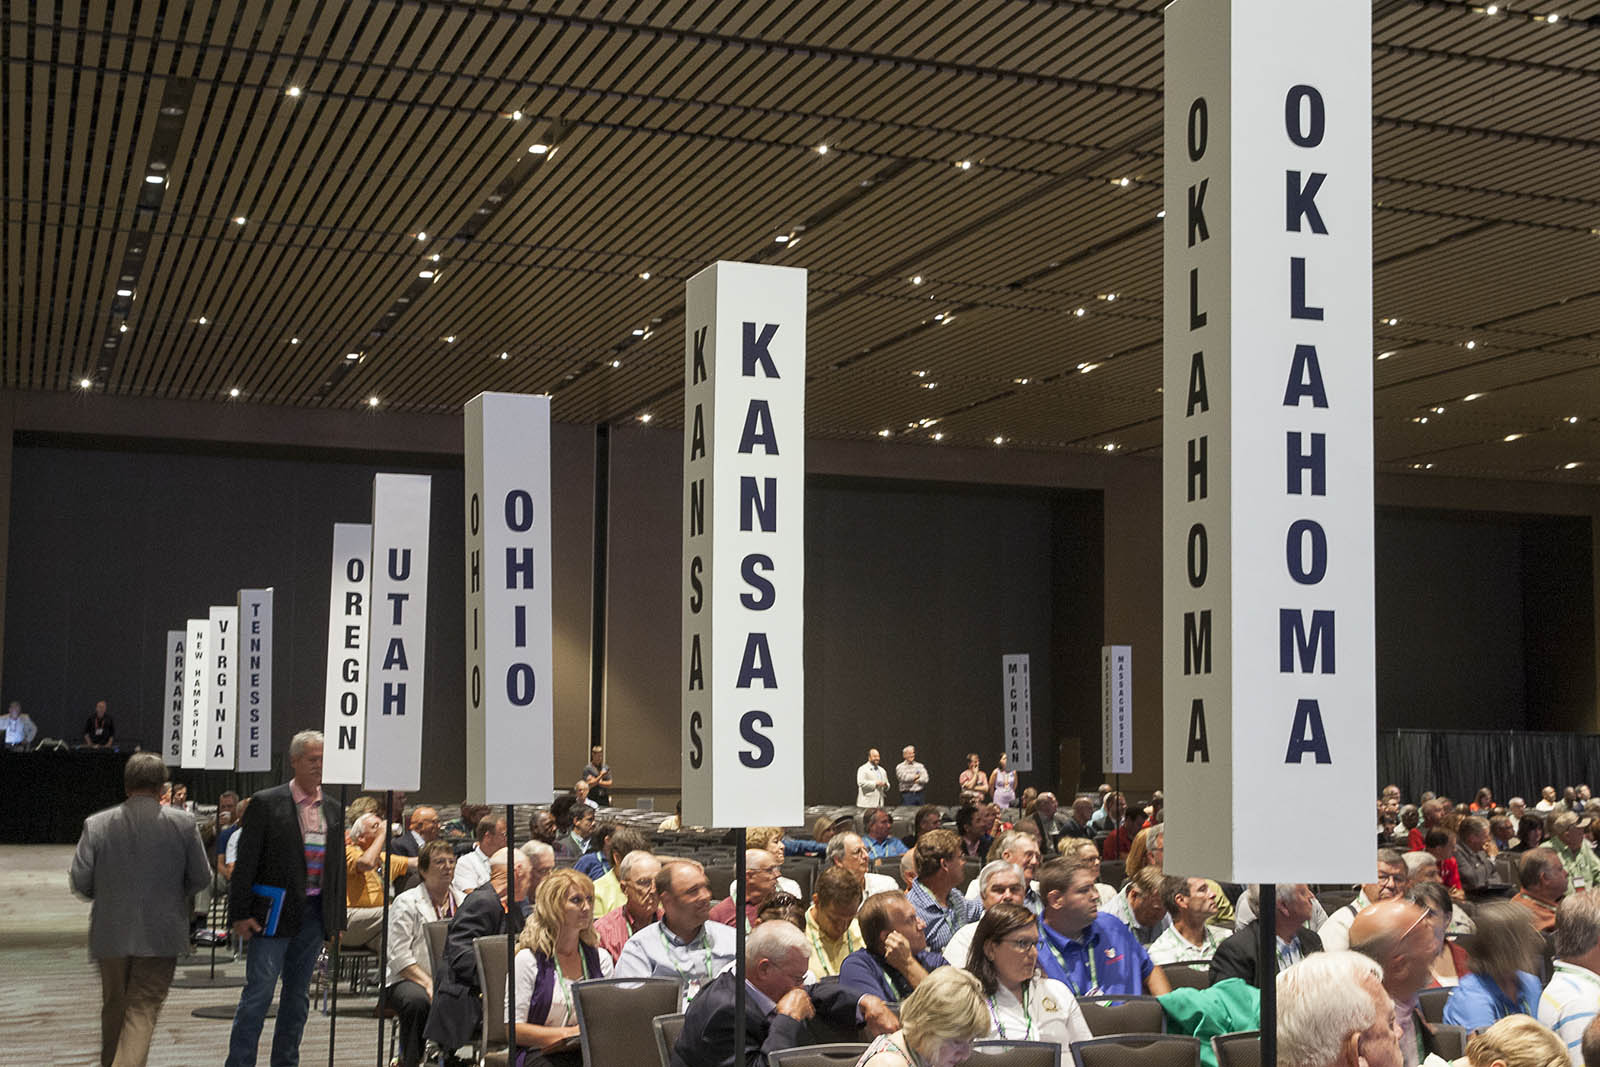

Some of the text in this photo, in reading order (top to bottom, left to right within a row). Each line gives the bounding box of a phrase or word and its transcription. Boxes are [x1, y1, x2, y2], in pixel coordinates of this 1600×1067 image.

[1183, 96, 1213, 764] OKLAHOMA
[1279, 83, 1337, 766] OKLAHOMA
[381, 548, 412, 716] UTAH
[470, 492, 480, 709] OHIO
[504, 489, 536, 707] OHIO
[688, 325, 708, 770] KANSAS
[735, 321, 782, 769] KANSAS
[171, 641, 184, 756] ARKANSAS
[191, 632, 203, 757] NEW HAMPSHIRE
[213, 620, 229, 758] VIRGINIA
[250, 603, 261, 758] TENNESSEE
[337, 558, 365, 750] OREGON
[1008, 663, 1019, 763] MICHIGAN
[1117, 655, 1125, 764] MASSACHUSETTS
